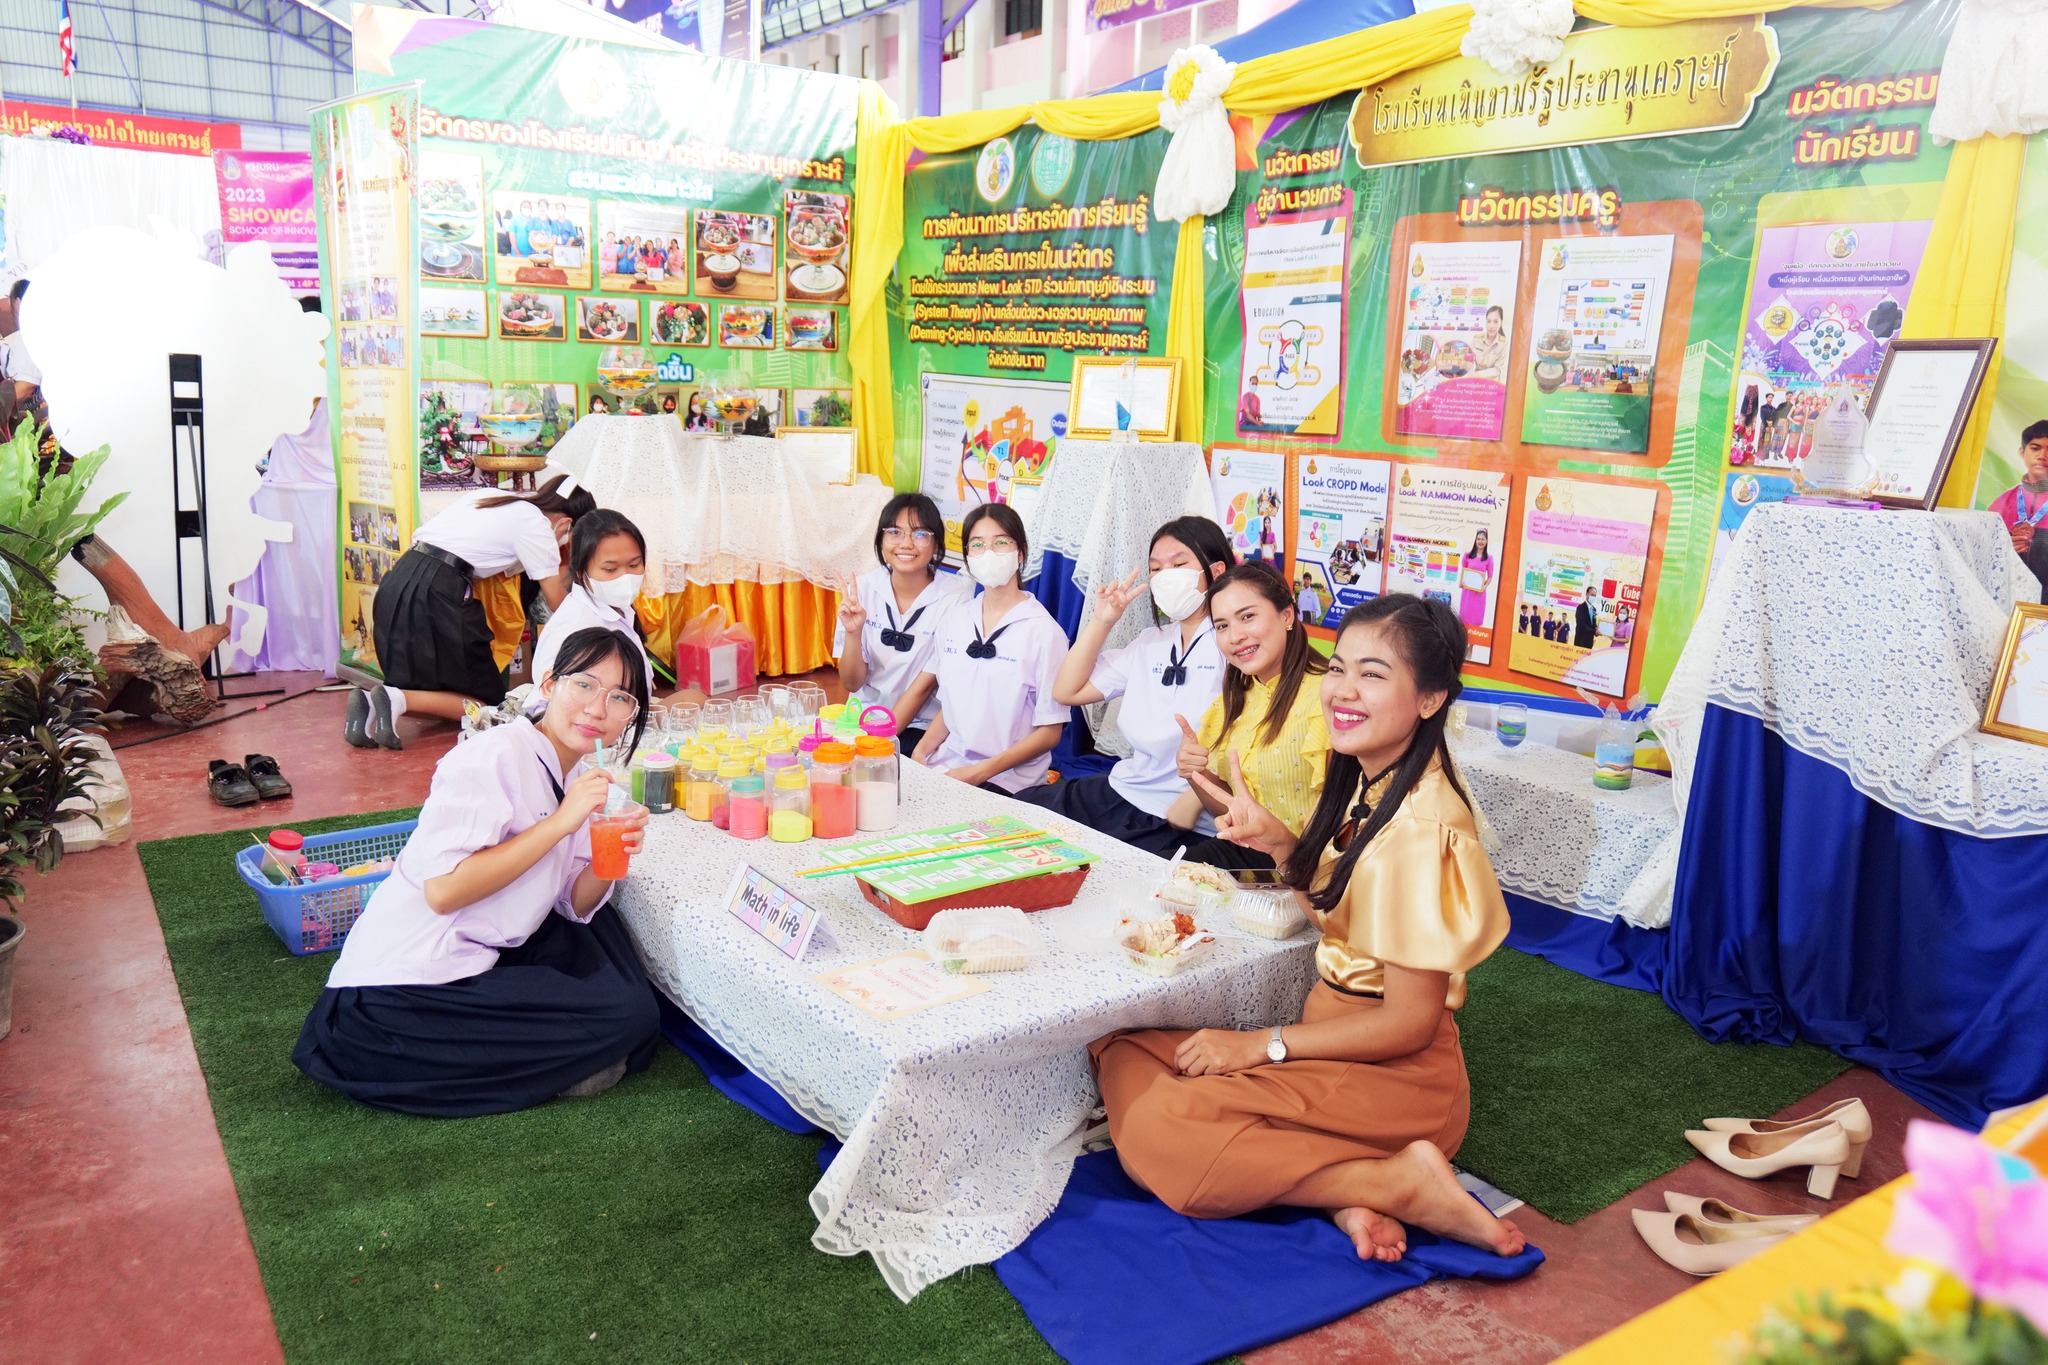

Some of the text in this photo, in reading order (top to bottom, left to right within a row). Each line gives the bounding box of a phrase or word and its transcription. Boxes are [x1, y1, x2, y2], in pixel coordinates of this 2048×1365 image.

[1373, 29, 1741, 136] โรงเรียนเนินขามรัฐประชานุเคราะห์
[1792, 75, 1938, 115] นวัตกรรม
[1798, 125, 1914, 163] นักเรียน
[245, 162, 280, 171] KHURU
[1265, 148, 1341, 176] นวัตกรรม
[225, 187, 266, 203] 2023
[1257, 184, 1342, 219] ผู้อำนวยการ
[228, 207, 316, 223] SHOWCA
[923, 195, 1148, 238] การพัฒนาการบริหารจัดการเรียนรู้
[1461, 189, 1616, 227] นวัตกรรมครู
[229, 226, 268, 235] SCHOOL
[270, 226, 282, 235] OF
[944, 240, 1113, 273] เพื่อส่งเสริมการเป็นนวัตกร
[978, 280, 999, 295] New
[1001, 280, 1023, 295] Look
[1024, 279, 1042, 295] 5TD
[1043, 276, 1155, 299] ร่วมกับทฤษฎีเชิงระบบ
[915, 303, 949, 322] (System
[950, 303, 981, 323] Theory)
[910, 324, 975, 344] (Deming-Cycle)
[988, 349, 1045, 368] จังหวัดชัยนาท
[988, 463, 996, 471] T2
[1302, 476, 1386, 494] Look CROPD Model
[1440, 480, 1487, 491] การใช้รูปแบบ
[1399, 488, 1496, 505] Look NAMMON Model
[1623, 586, 1640, 600] Tube
[1601, 600, 1616, 613] You
[740, 884, 801, 938] Math in life
